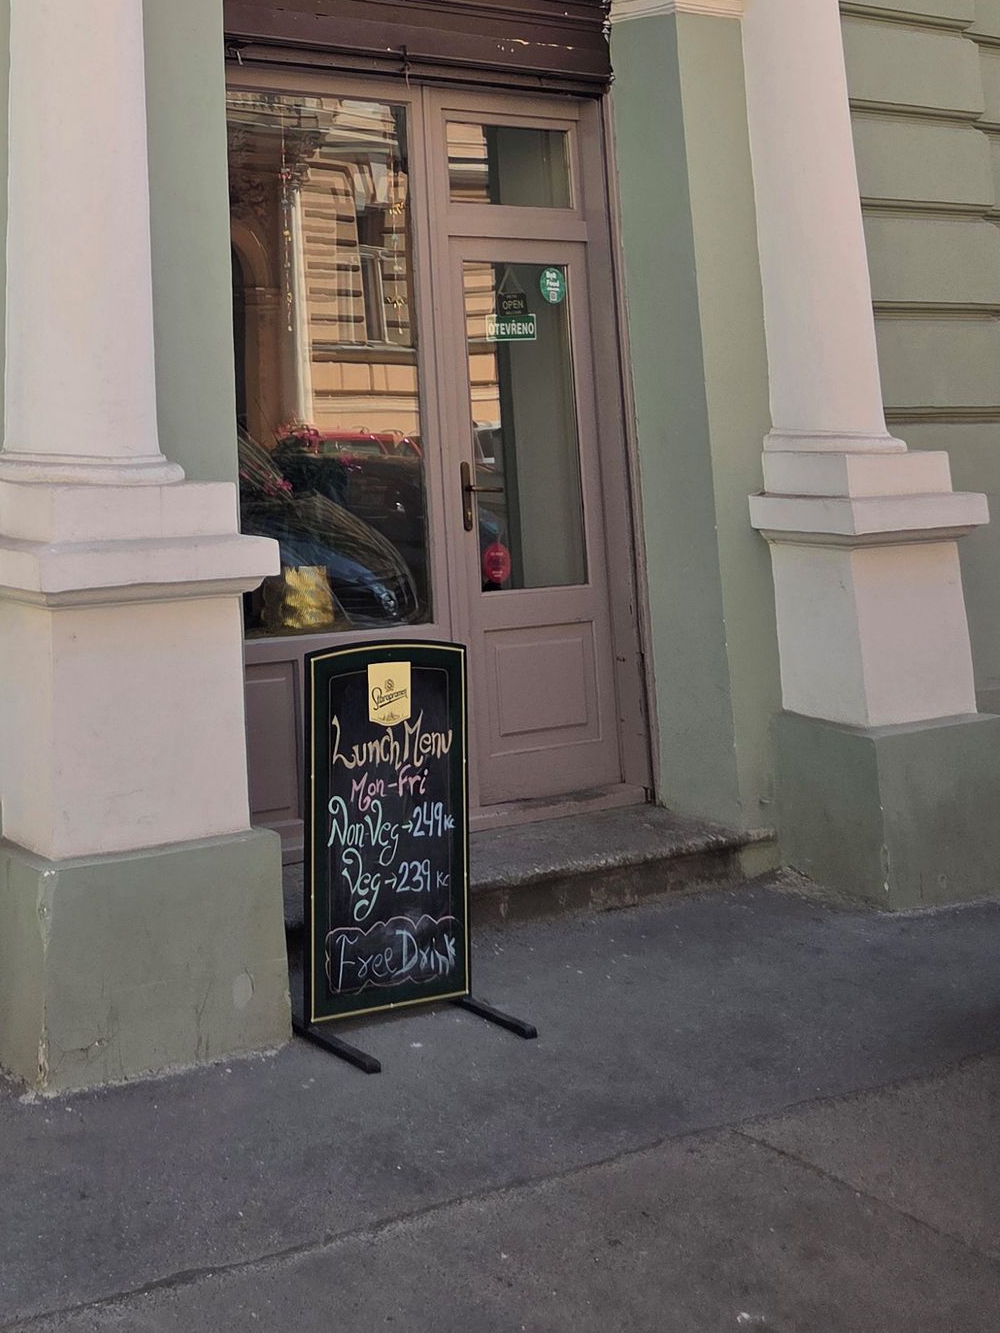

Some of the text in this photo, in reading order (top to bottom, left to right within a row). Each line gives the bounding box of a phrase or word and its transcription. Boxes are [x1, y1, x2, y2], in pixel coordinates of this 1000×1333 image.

[488, 319, 535, 336] OTEVŘENO
[502, 300, 525, 310] OPEN
[332, 709, 453, 771] Lunch Menu
[413, 801, 444, 837] 249
[341, 847, 381, 921] Veg
[396, 859, 431, 892] 239
[336, 929, 457, 992] Free Drink
